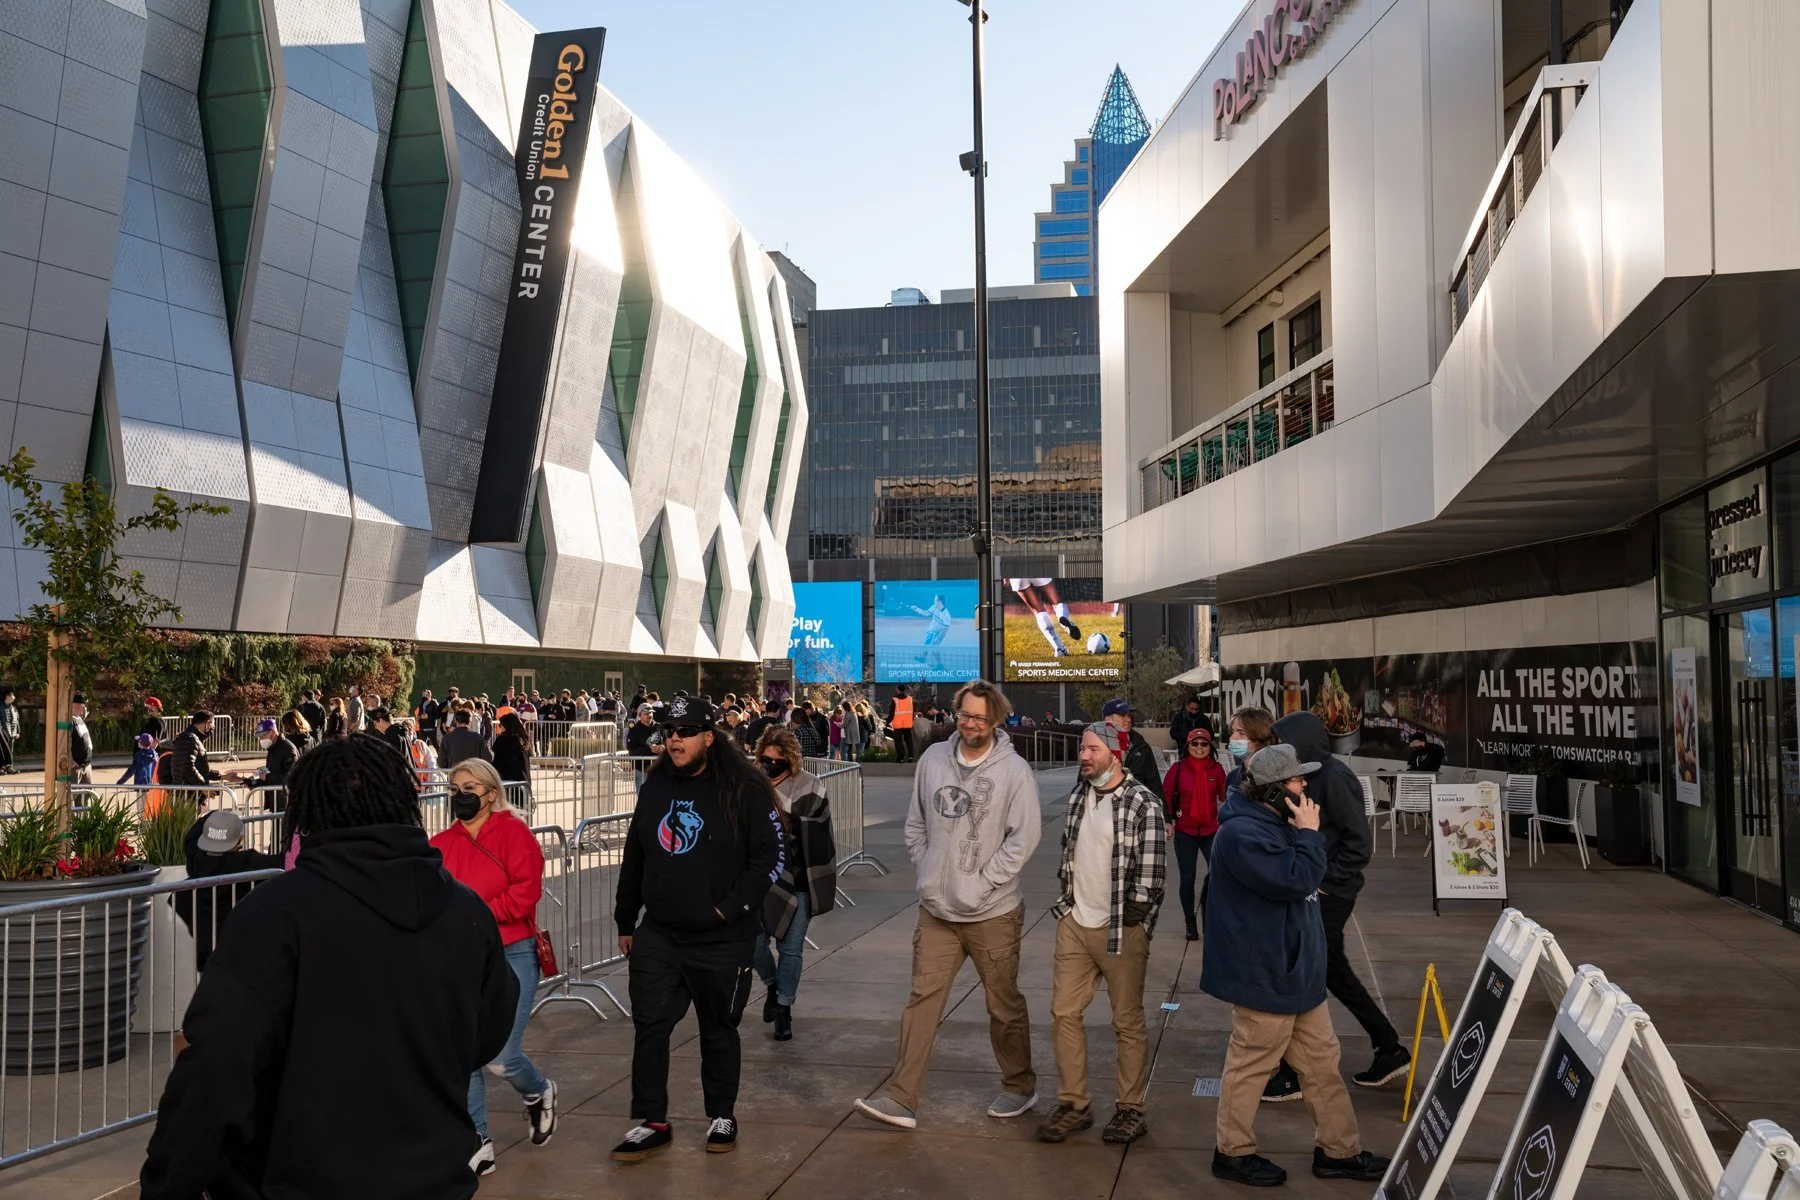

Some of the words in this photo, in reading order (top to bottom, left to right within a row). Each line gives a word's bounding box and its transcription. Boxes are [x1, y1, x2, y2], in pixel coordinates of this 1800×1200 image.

[533, 93, 550, 136] Credit
[542, 43, 587, 159] Golden
[525, 140, 543, 181] Union
[539, 163, 570, 181] 1
[518, 185, 555, 299] CENTER
[1708, 483, 1761, 539] pressed
[1709, 543, 1762, 587] juicery
[791, 616, 823, 633] Play
[805, 634, 835, 649] fun.
[888, 670, 916, 679] SPORTS
[917, 669, 954, 678] MEDICINE
[956, 669, 981, 677] CENTE
[1017, 669, 1047, 677] SPORTS
[1048, 668, 1086, 677] MEDICINE
[1088, 668, 1119, 676] CENTER
[1476, 669, 1511, 698] ALL
[1515, 668, 1556, 698] THE
[1222, 666, 1277, 725] TOM'S
[1491, 704, 1528, 733] ALL
[1533, 704, 1574, 736] THE
[1483, 741, 1510, 755] LEARN
[1511, 743, 1535, 757] MOR
